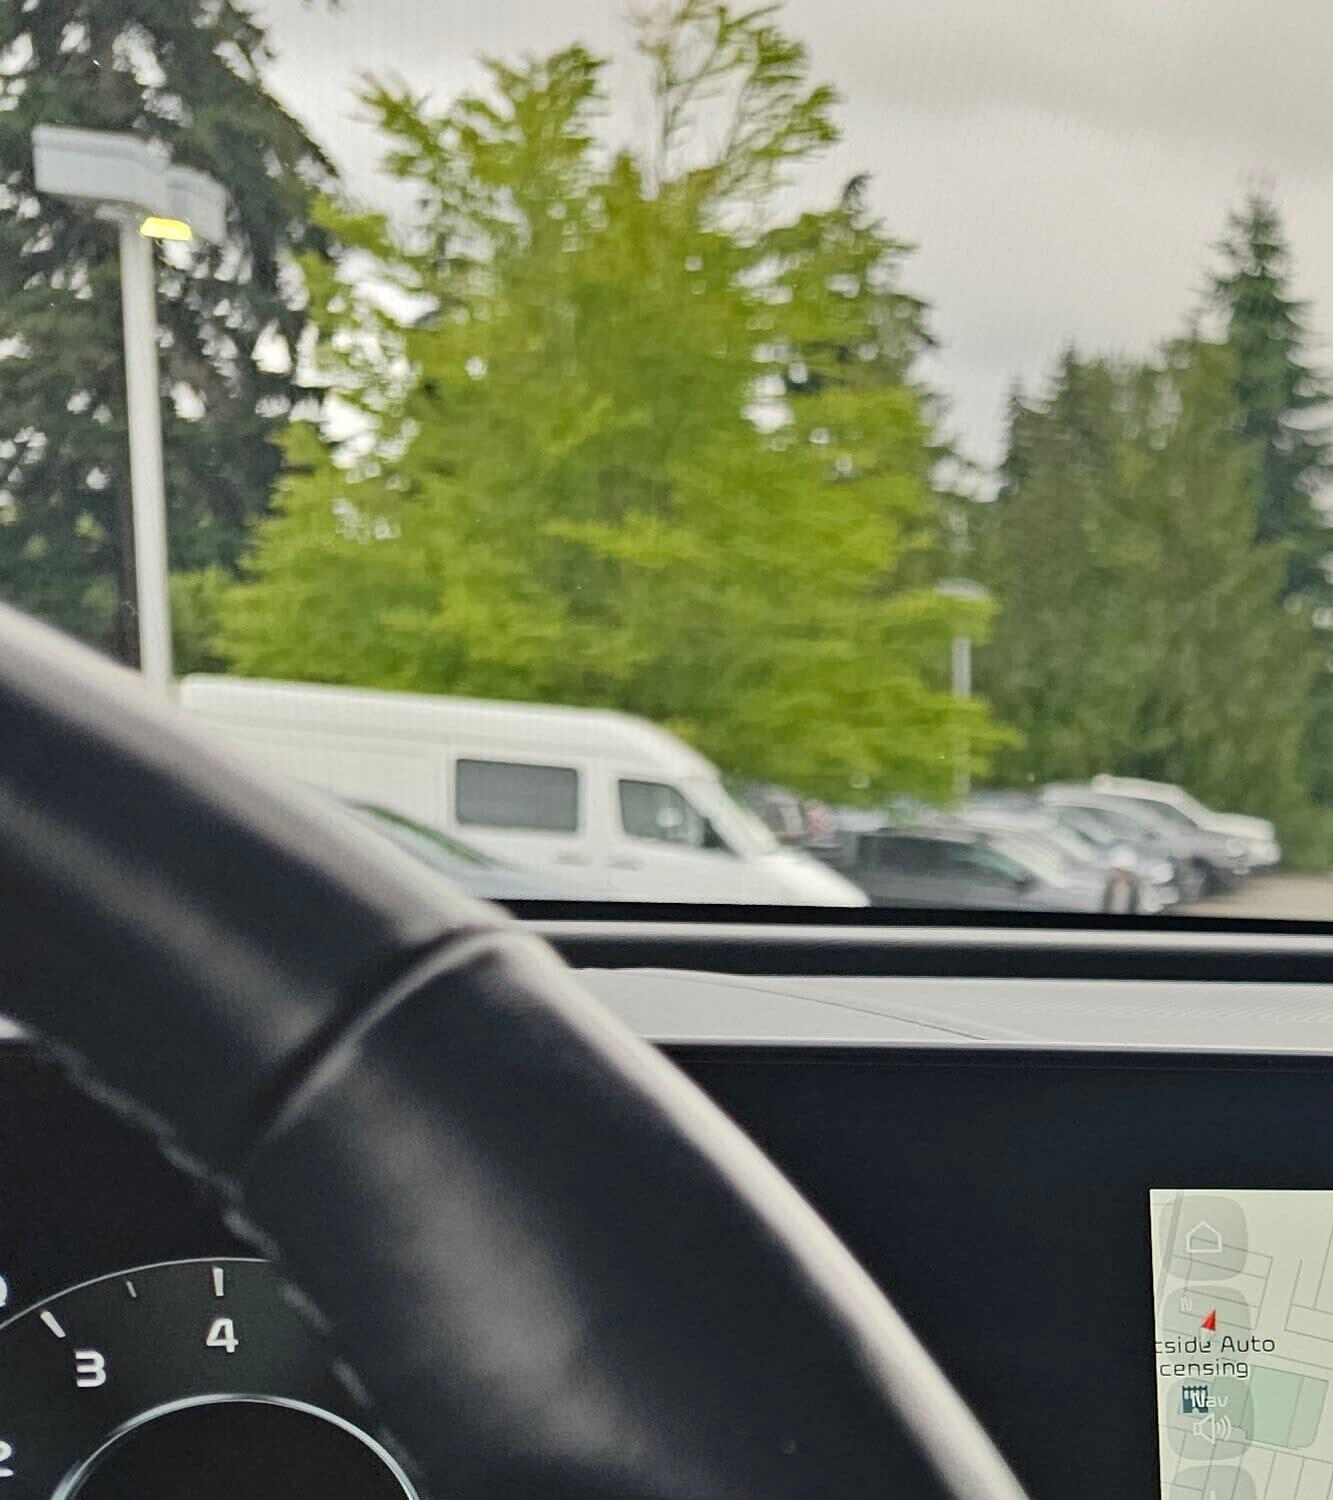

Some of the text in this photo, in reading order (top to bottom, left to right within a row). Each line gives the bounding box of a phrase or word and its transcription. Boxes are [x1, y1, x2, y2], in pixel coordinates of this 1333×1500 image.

[205, 1317, 239, 1353] 4
[1221, 1336, 1275, 1353] Auto
[74, 1350, 107, 1388] 3
[1160, 1358, 1249, 1379] censing
